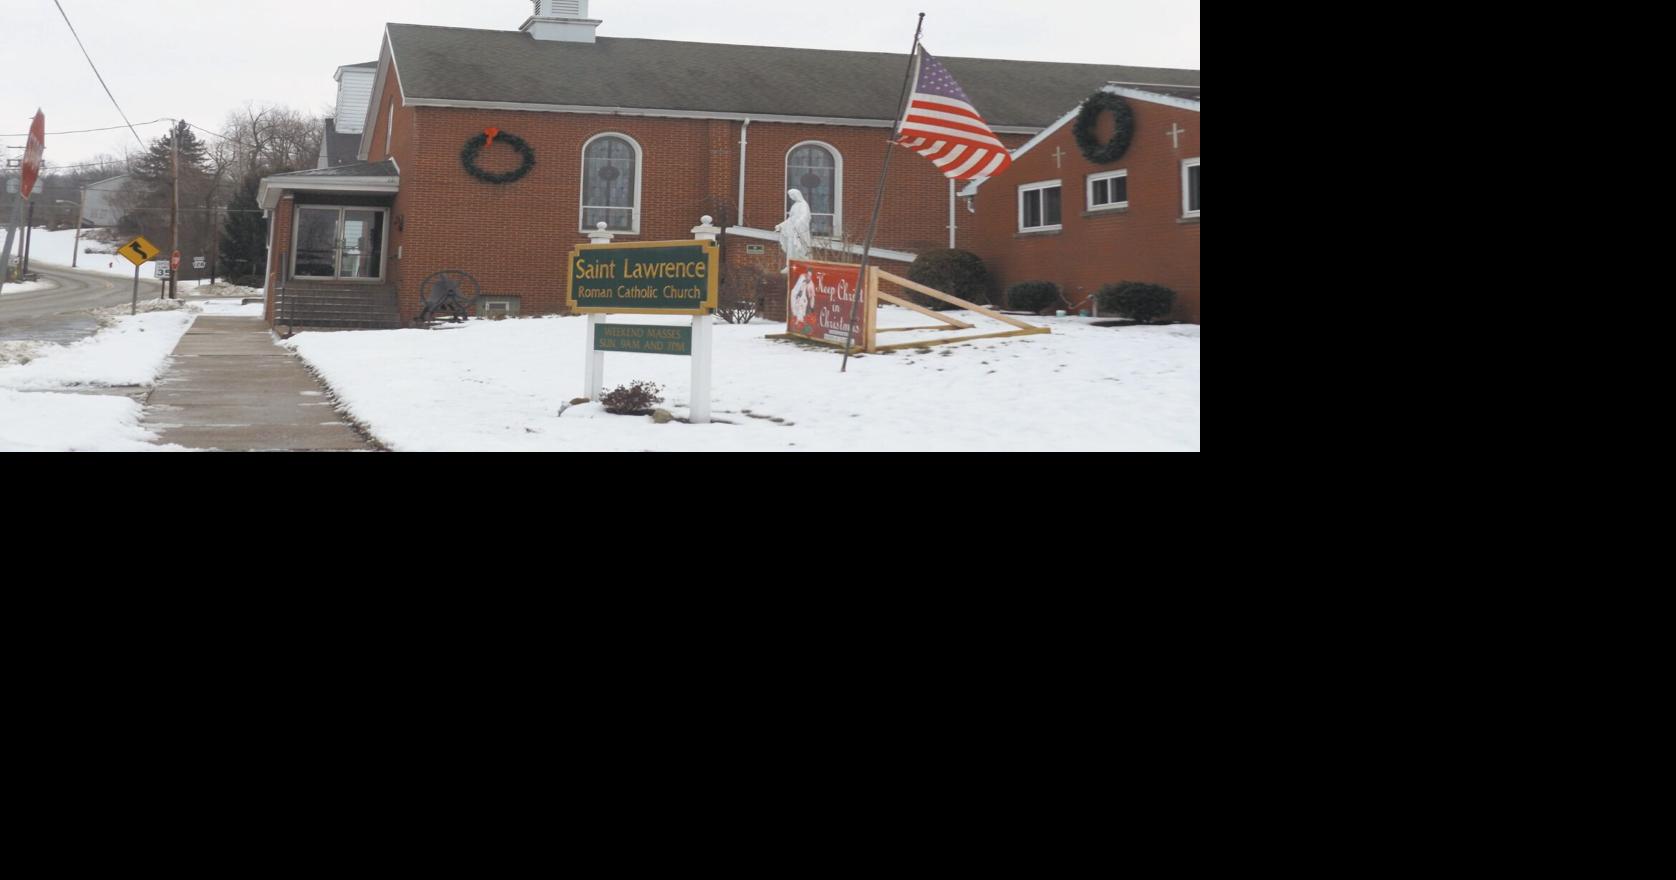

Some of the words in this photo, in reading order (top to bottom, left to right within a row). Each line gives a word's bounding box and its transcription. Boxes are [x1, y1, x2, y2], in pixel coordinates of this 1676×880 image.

[576, 258, 615, 279] Saint
[624, 258, 705, 279] Lawrence
[578, 285, 612, 298] Roman
[617, 285, 658, 298] Catholic
[663, 285, 701, 299] Church
[815, 271, 835, 302] Keep
[837, 278, 864, 303] Chrit
[831, 299, 840, 313] in
[604, 327, 644, 338] WEEKEND
[647, 328, 681, 339] MASSES
